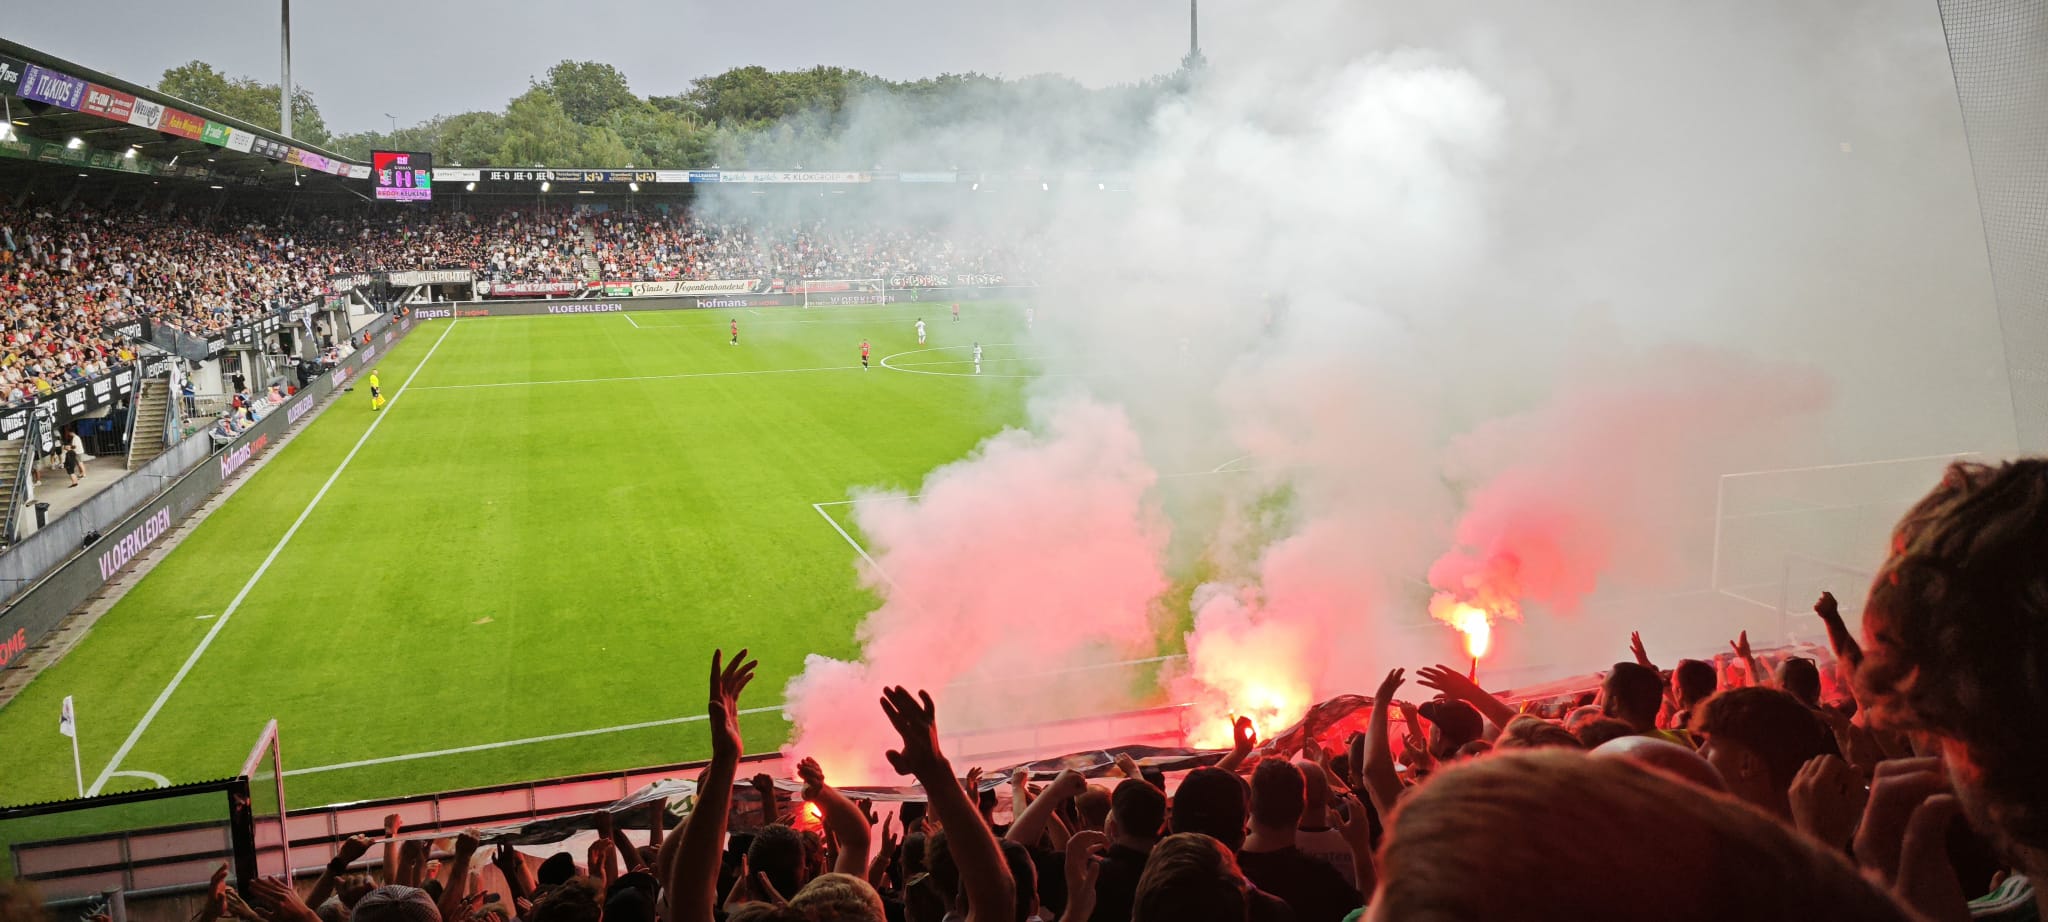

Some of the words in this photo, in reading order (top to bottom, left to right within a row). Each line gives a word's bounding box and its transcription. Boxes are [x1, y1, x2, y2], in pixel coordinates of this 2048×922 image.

[36, 74, 72, 102] IT4KIDS
[490, 172, 510, 180] JEE-O
[513, 172, 532, 180] JEE-O
[548, 303, 622, 313] VLOERKLEDEN
[65, 387, 86, 407] UNIBET
[1, 409, 27, 433] UNIBET
[98, 505, 171, 581] VLOERKLEDEN
